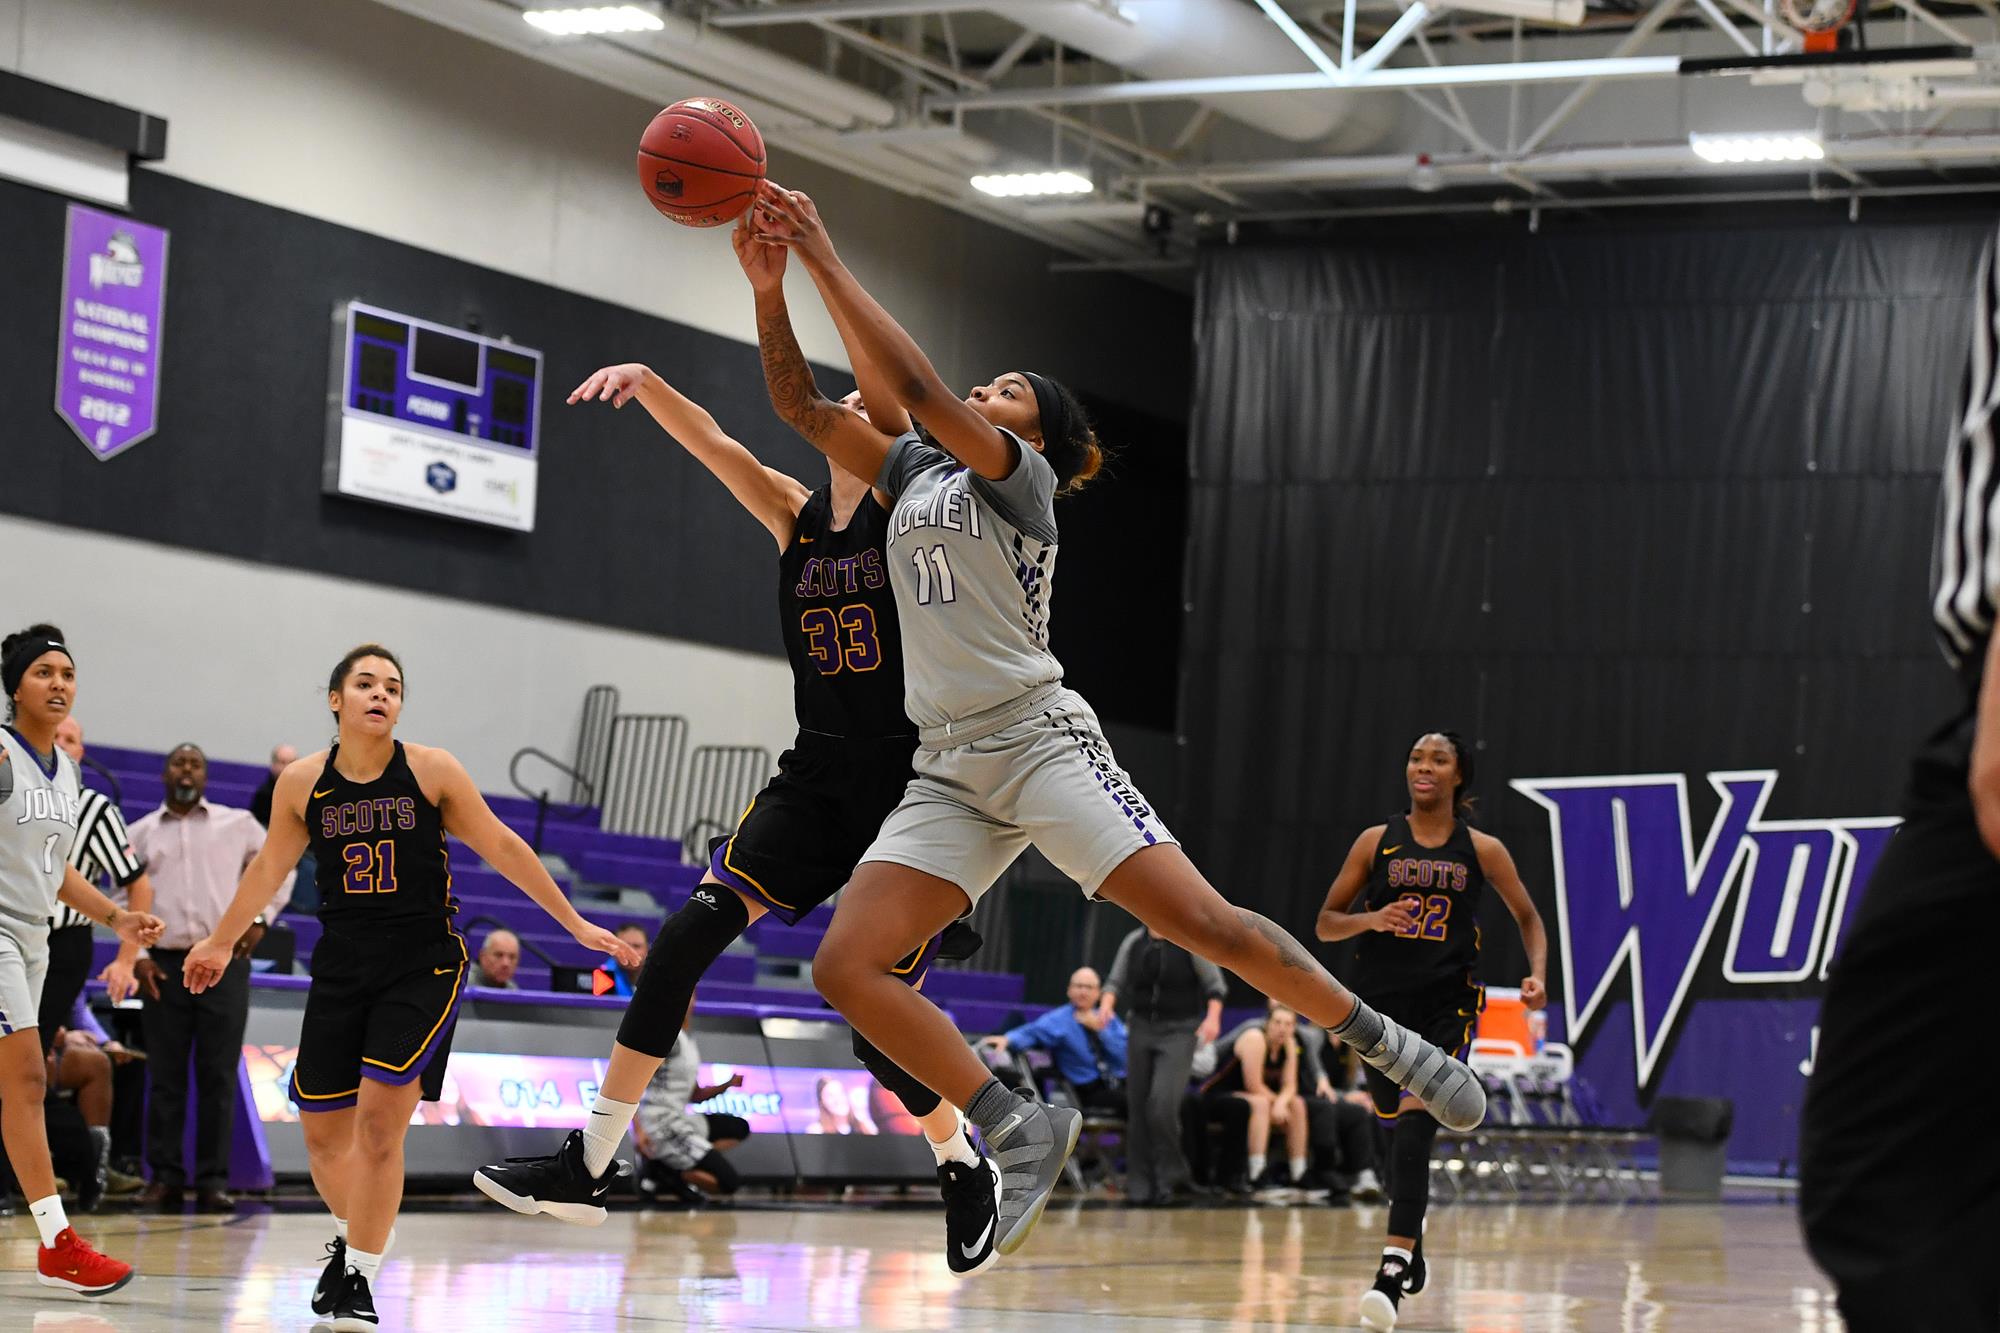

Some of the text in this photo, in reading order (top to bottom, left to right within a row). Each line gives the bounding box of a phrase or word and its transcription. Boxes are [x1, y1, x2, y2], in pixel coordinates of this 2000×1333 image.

[79, 395, 131, 428] 2012
[912, 544, 956, 605] 11
[801, 603, 882, 675] 33
[17, 786, 80, 831] JOLIE
[321, 796, 416, 838] SCOTS
[43, 832, 61, 875] 1
[342, 839, 398, 894] 21
[1388, 857, 1467, 892] SCOTS
[1394, 893, 1452, 942] 22
[500, 1079, 561, 1108] #14
